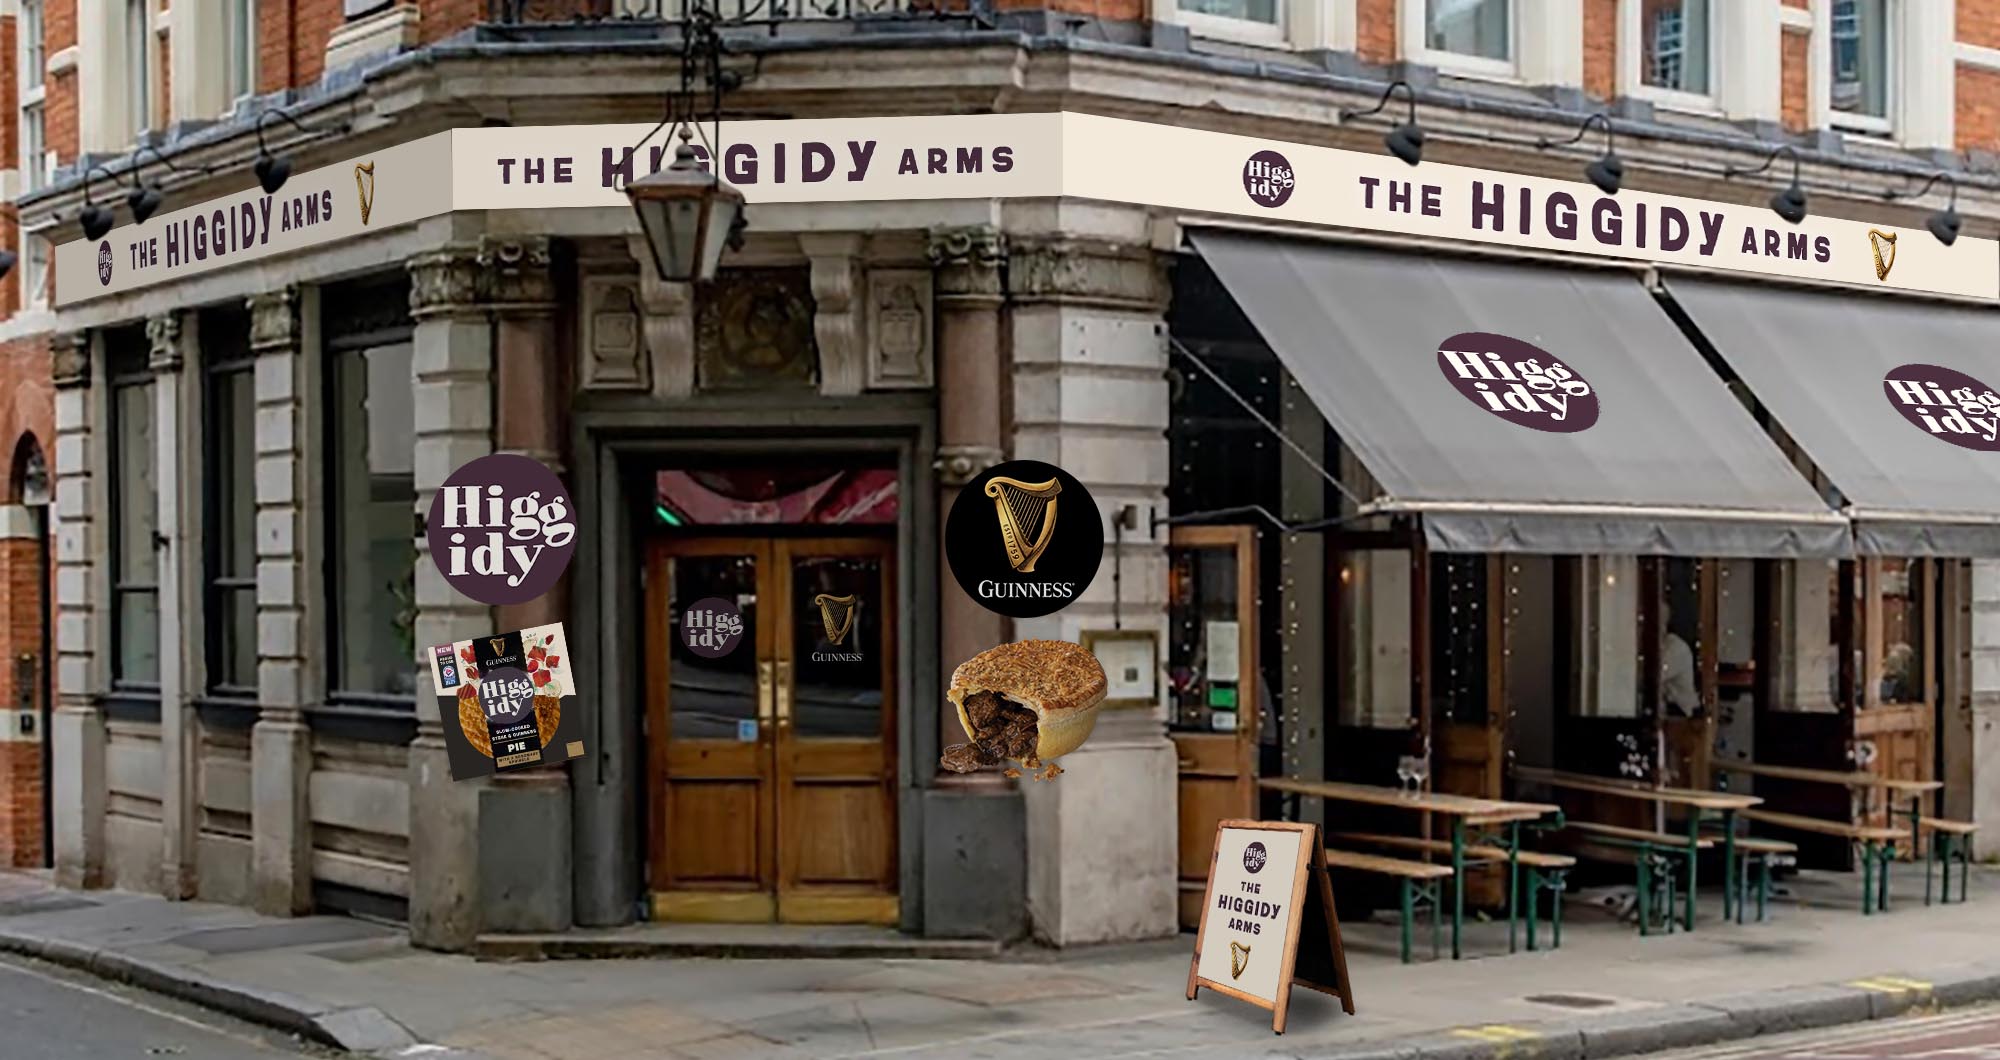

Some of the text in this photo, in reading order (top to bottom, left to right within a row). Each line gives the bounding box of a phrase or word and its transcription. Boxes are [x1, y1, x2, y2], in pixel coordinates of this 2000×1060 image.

[497, 157, 574, 185] THE
[898, 146, 1014, 175] ARMS
[1247, 160, 1294, 188] Higg
[1250, 178, 1284, 201] idy
[130, 189, 332, 270] THE HIGGIDY ARMS
[1358, 176, 1831, 262] THE HIGGIDY ARMS
[1437, 350, 1590, 396] Higg
[1474, 382, 1568, 420] idy
[1915, 407, 1998, 441] idy
[440, 484, 576, 548] Higg
[448, 532, 546, 587] idy
[978, 580, 1073, 598] GUINNESS
[685, 609, 744, 635] Higg
[436, 646, 452, 654] NEW
[688, 628, 731, 651] idy
[485, 656, 517, 666] GUINNESS
[812, 651, 863, 662] GUINNESS
[482, 678, 534, 699] Higg
[487, 696, 524, 716] idy
[507, 742, 526, 752] PIE
[1240, 881, 1261, 895] THE
[1218, 894, 1281, 920] HIGGIDY
[1228, 917, 1261, 935] ARMS
